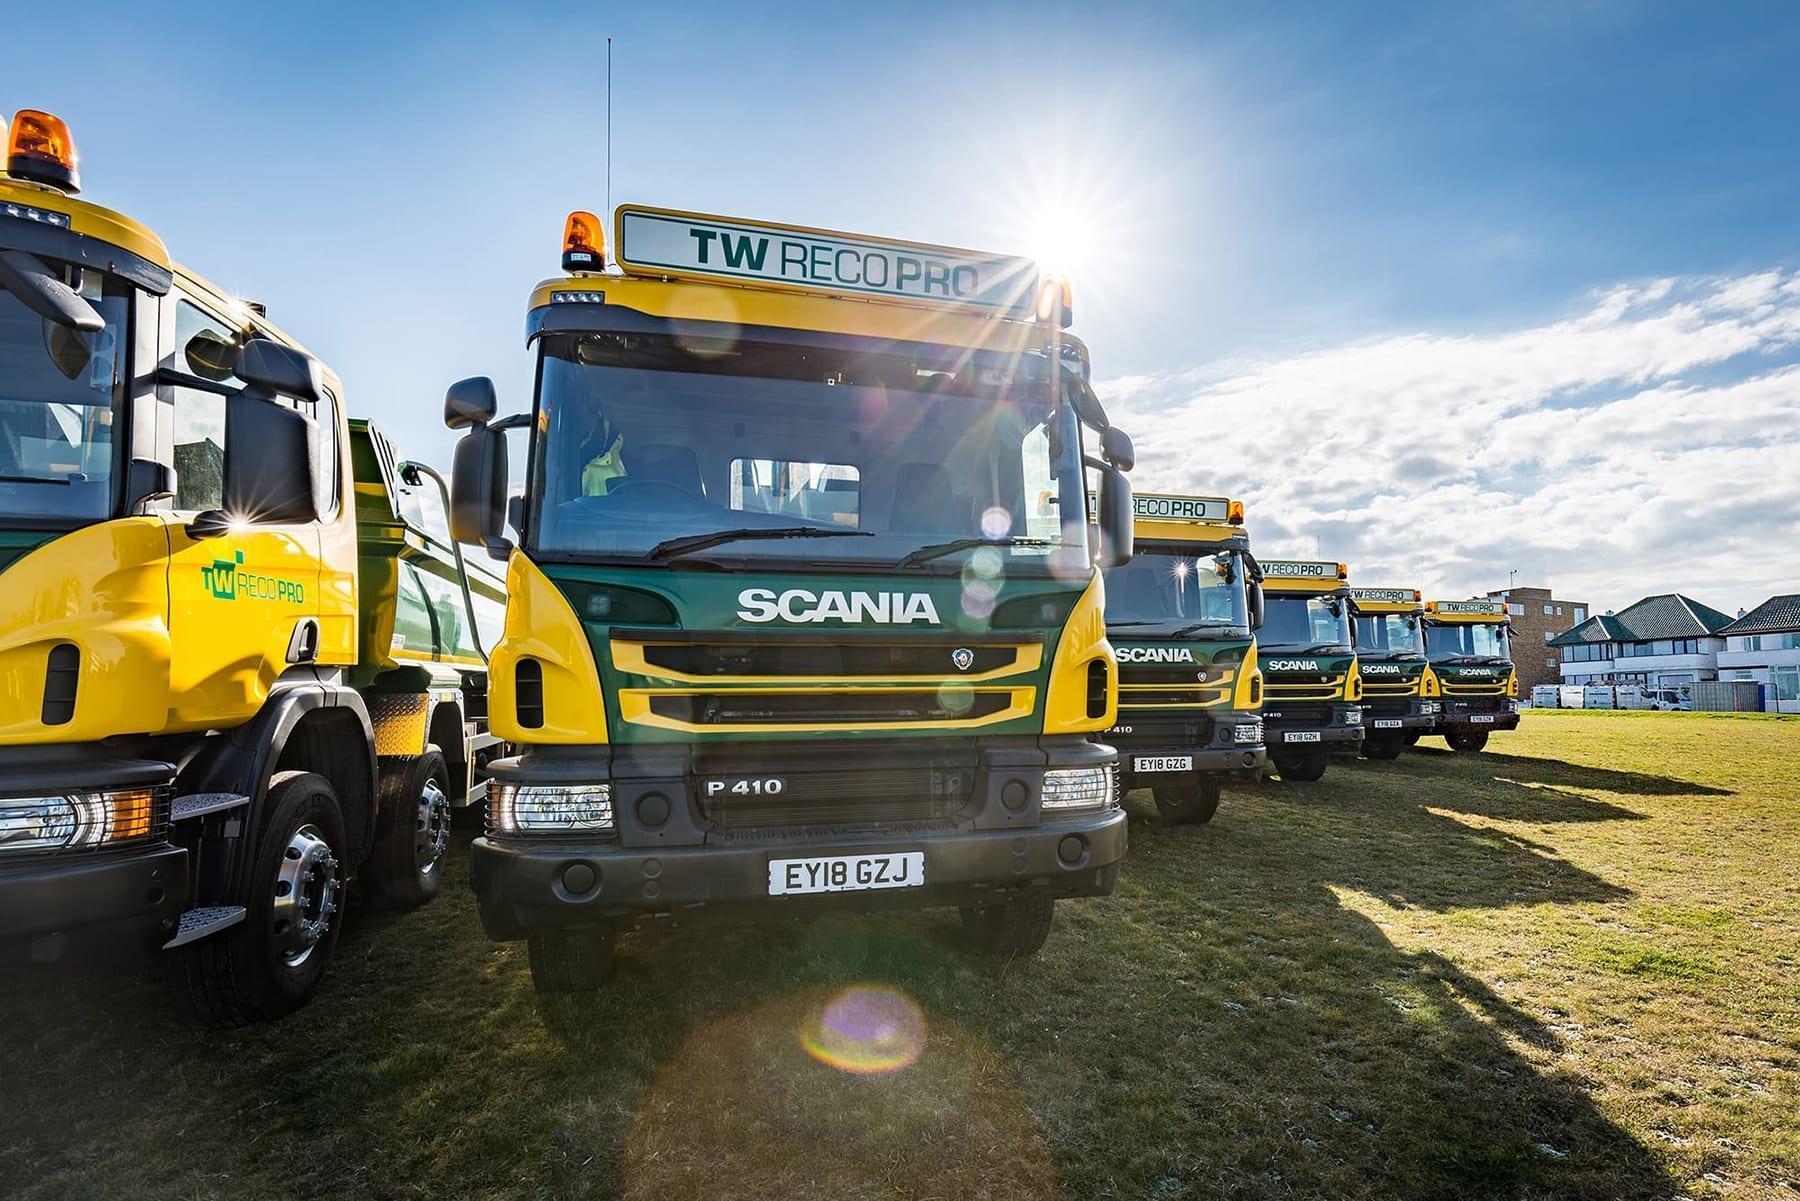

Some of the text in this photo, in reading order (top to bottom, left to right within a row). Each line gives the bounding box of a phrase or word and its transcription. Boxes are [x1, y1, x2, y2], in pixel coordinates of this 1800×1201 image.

[689, 228, 979, 297] TW RECO PRO
[1171, 502, 1206, 517] PRO
[1272, 564, 1300, 576] RECO
[1301, 565, 1323, 576] PRO
[201, 564, 304, 603] TW RECO PRO
[1387, 591, 1404, 600] PRO
[736, 588, 941, 625] SCANIA
[1447, 603, 1460, 611] TW
[1115, 648, 1193, 663] SCANIA
[1269, 660, 1318, 671] SCANIA
[1362, 665, 1400, 674] SCANIA
[1459, 668, 1491, 677] SCANIA
[1140, 758, 1187, 770] EY18 GZG
[707, 779, 783, 796] P 410
[786, 857, 908, 889] EY18 GZJ
